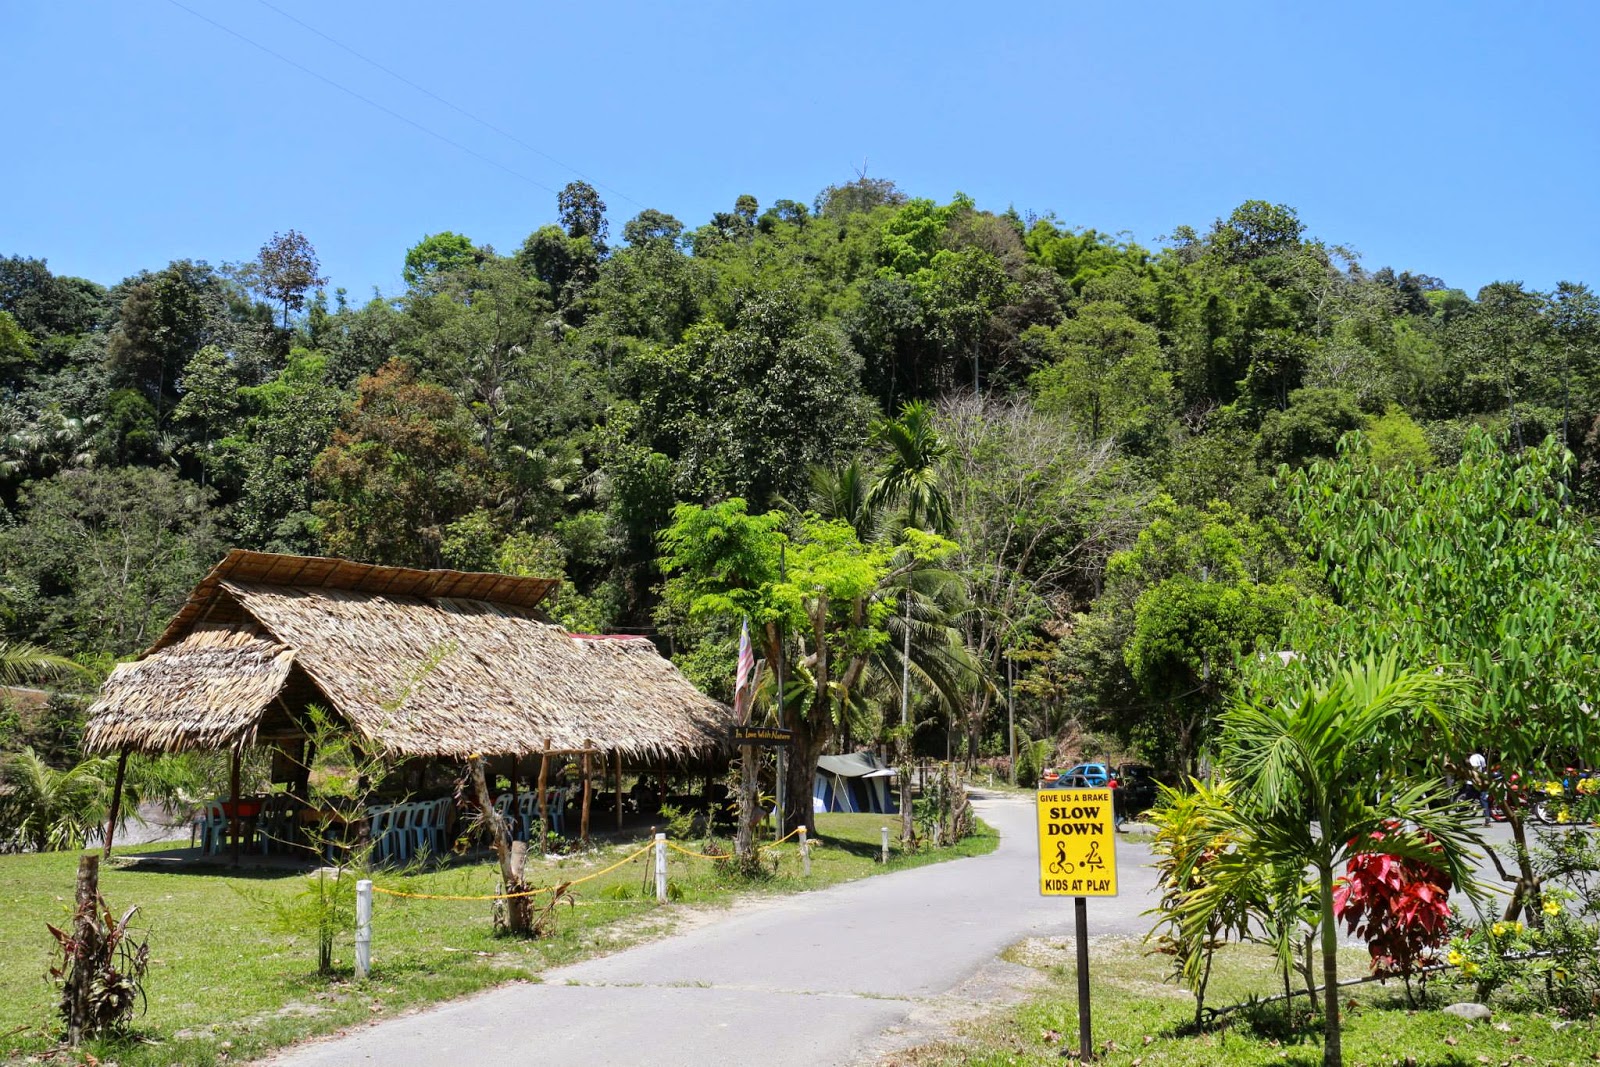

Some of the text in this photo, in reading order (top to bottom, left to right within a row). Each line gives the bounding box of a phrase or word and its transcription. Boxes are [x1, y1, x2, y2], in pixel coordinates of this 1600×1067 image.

[1061, 794, 1072, 802] US
[1082, 793, 1108, 801] BRAKE
[1050, 807, 1100, 819] SLOW
[1048, 823, 1104, 835] DOWN
[1045, 879, 1110, 891] KIDS AT PLAY
